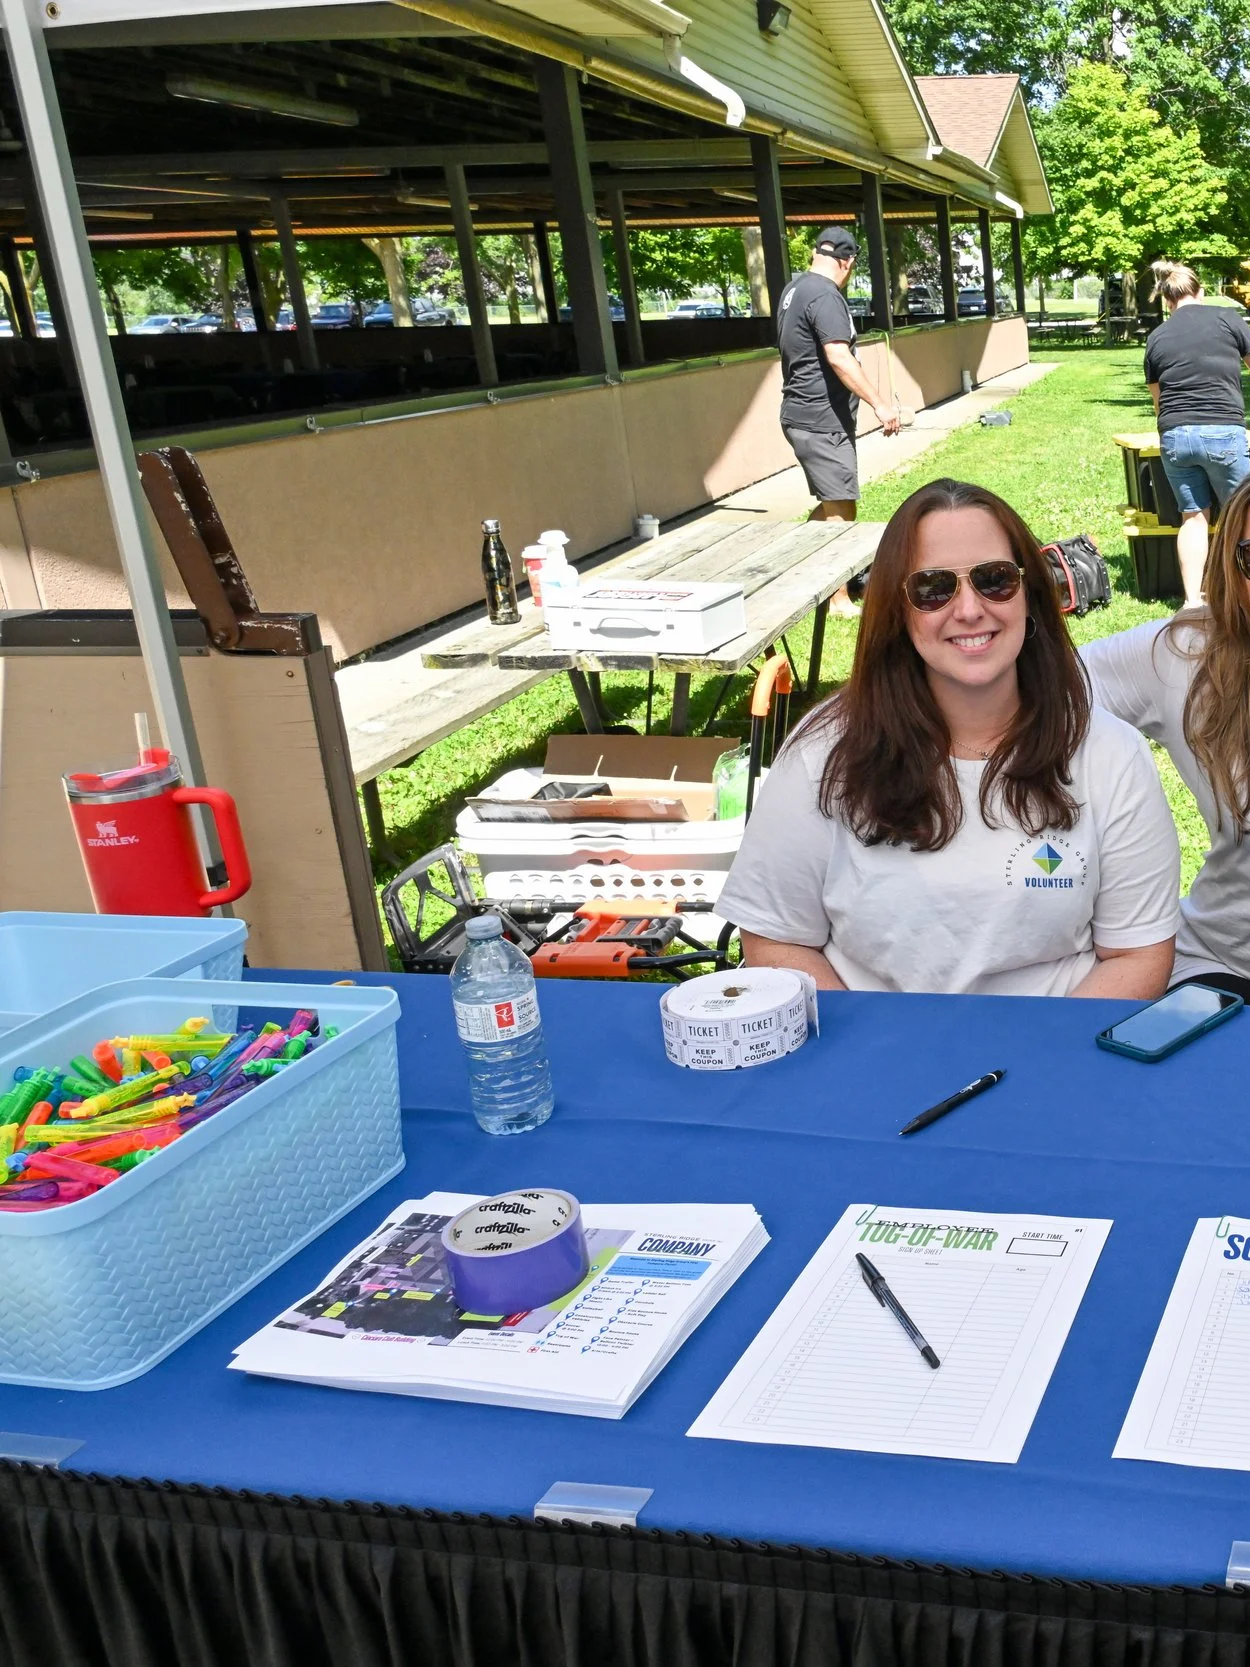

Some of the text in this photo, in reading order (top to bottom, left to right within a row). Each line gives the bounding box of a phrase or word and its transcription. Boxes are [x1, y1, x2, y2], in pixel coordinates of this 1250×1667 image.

[88, 835, 136, 847] STANLEY
[1006, 838, 1031, 886] STERLING
[1025, 877, 1073, 888] VOLUNTEER
[688, 1026, 719, 1037] TICKET
[741, 1017, 773, 1034] TICKET
[750, 1040, 770, 1051] KEEP
[744, 1049, 776, 1062] COUPON
[876, 1220, 994, 1233] EMPLOYEE
[644, 1232, 676, 1240] STERLING
[858, 1222, 998, 1251] TUG-OF-WAR
[637, 1237, 716, 1256] COMPANY
